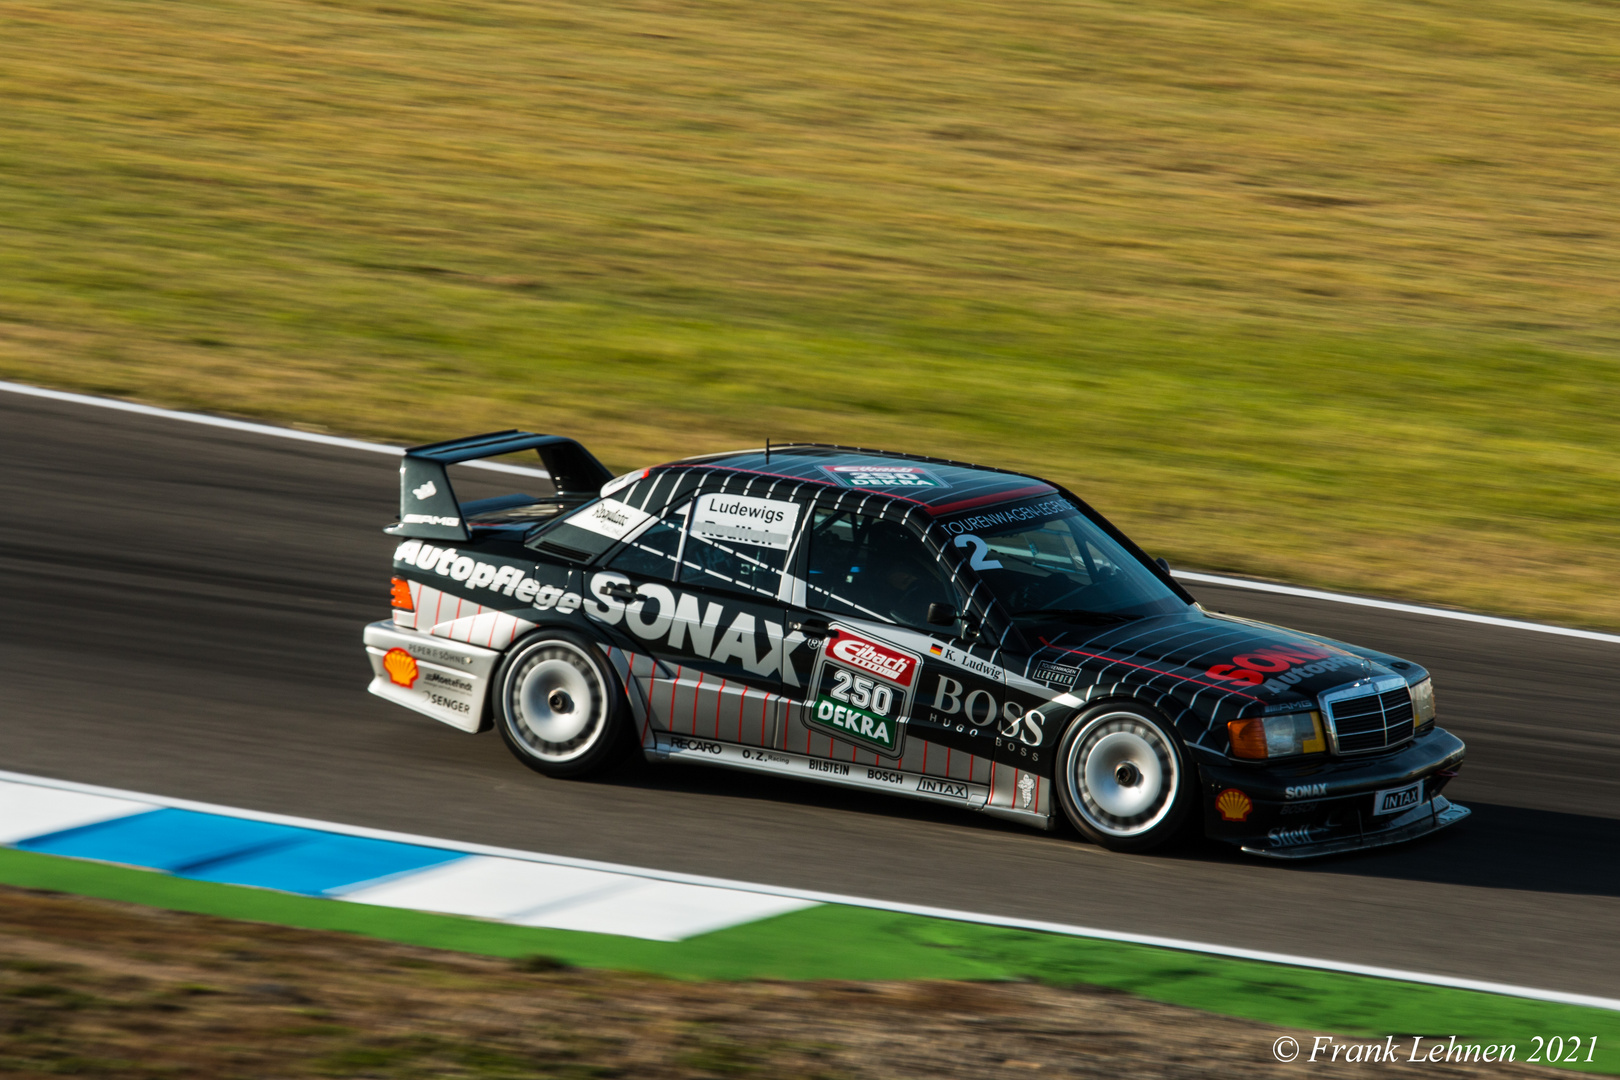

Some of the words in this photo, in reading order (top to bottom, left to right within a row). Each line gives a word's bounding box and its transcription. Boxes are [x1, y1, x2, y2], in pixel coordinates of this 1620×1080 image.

[849, 472, 920, 480] 250
[709, 498, 784, 524] Ludewigs
[954, 534, 1004, 571] 2
[394, 539, 583, 615] Autopflege
[583, 571, 807, 688] SONAX
[833, 639, 909, 674] Eibach
[944, 649, 957, 661] K.
[961, 656, 1002, 680] Ludwig
[830, 669, 893, 716] 250
[431, 694, 471, 715] SENGER
[931, 674, 1046, 747] BOSS
[1278, 700, 1312, 711] AMG
[817, 700, 890, 744] DEKRA
[671, 737, 722, 755] RECARO
[929, 713, 979, 738] HUGO
[995, 736, 1039, 762] BOSS
[768, 755, 790, 765] Racing
[809, 759, 850, 776] BILSTEIN
[867, 769, 903, 784] BOSCH
[922, 780, 964, 796] INTAX
[1285, 783, 1327, 799] SONAX
[1384, 789, 1417, 809] INTAX
